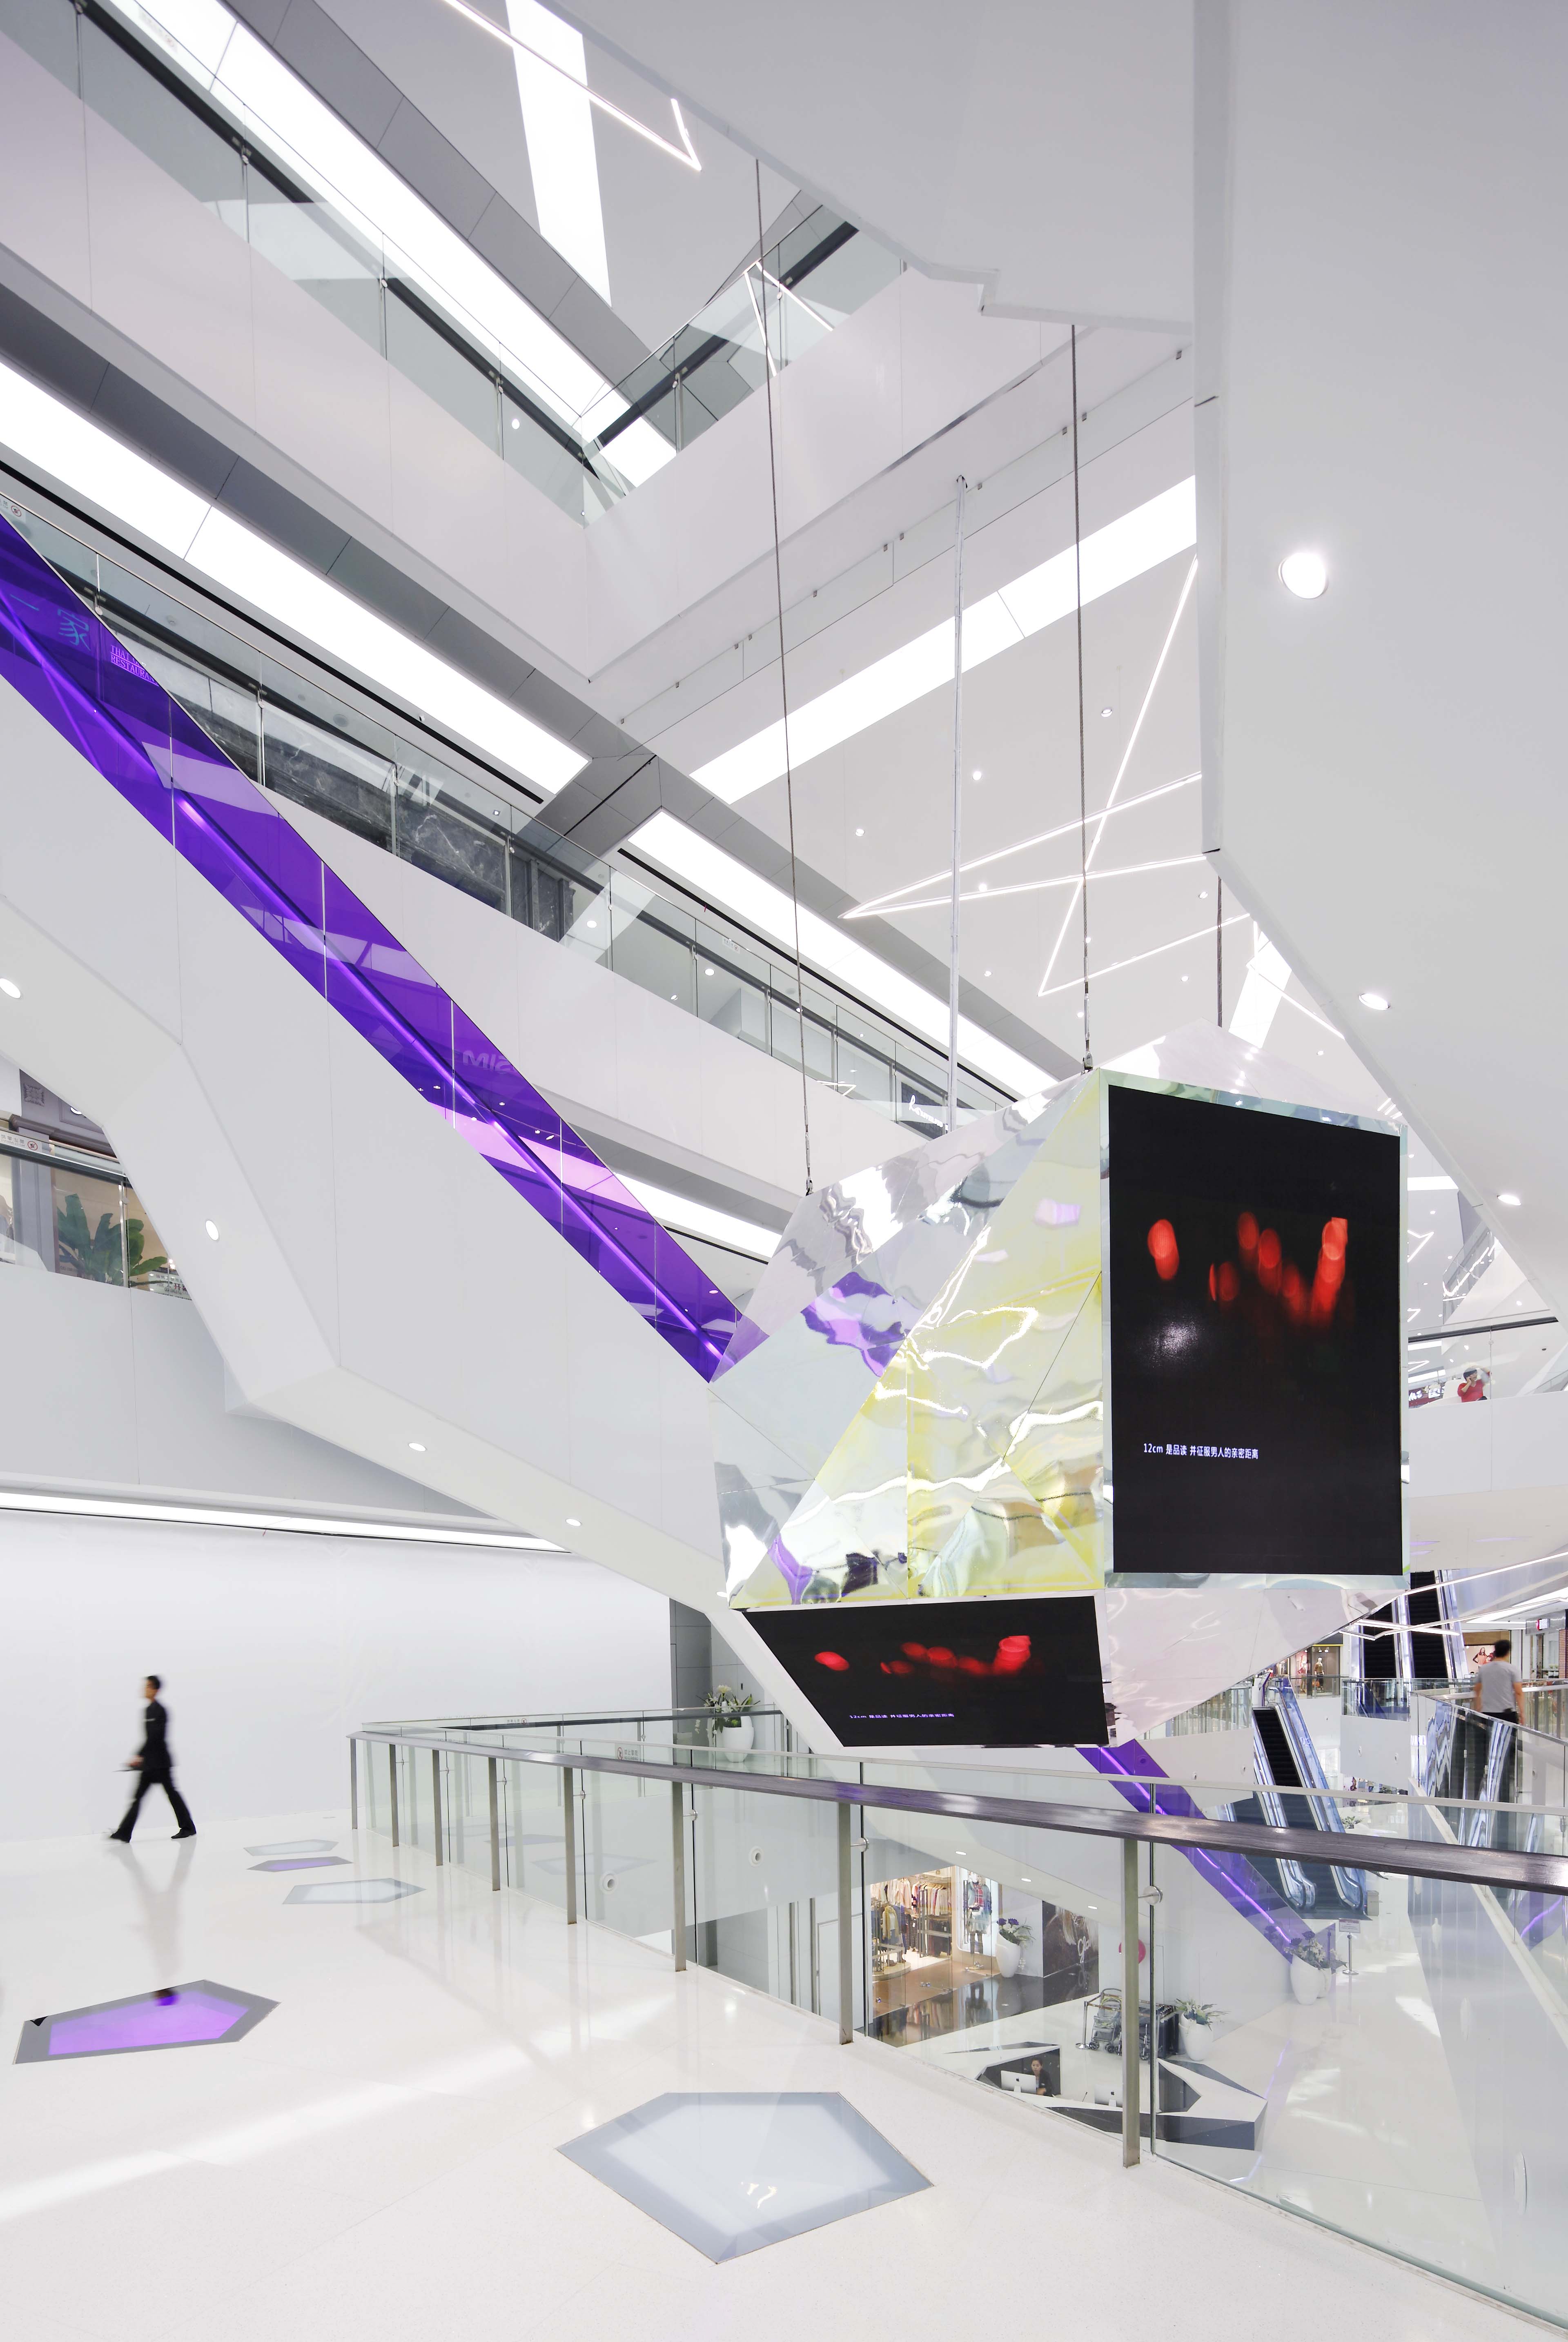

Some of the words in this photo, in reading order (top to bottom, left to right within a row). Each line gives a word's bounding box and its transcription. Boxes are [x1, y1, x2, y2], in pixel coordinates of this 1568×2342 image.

[111, 654, 158, 685] RESTAURAN
[1144, 1443, 1163, 1453] 12cm
[1165, 1444, 1187, 1456] 是品读
